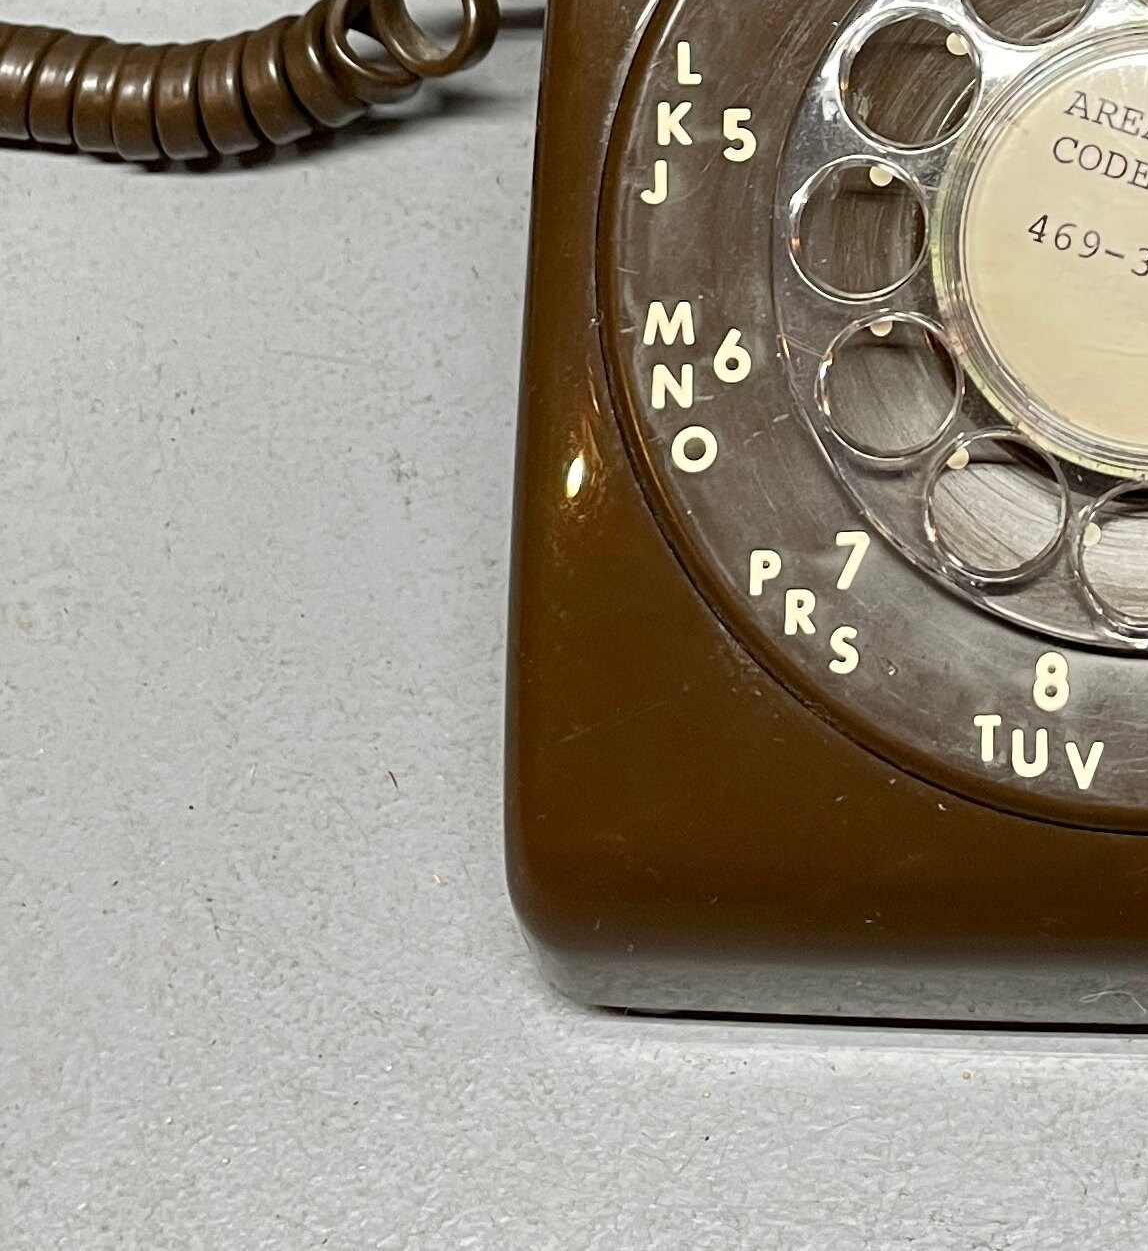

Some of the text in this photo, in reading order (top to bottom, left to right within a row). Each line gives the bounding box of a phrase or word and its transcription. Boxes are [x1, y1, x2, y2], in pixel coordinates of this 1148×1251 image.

[722, 108, 757, 162] 5
[713, 328, 752, 383] 6
[834, 530, 871, 590] 7
[1032, 652, 1070, 712] 8
